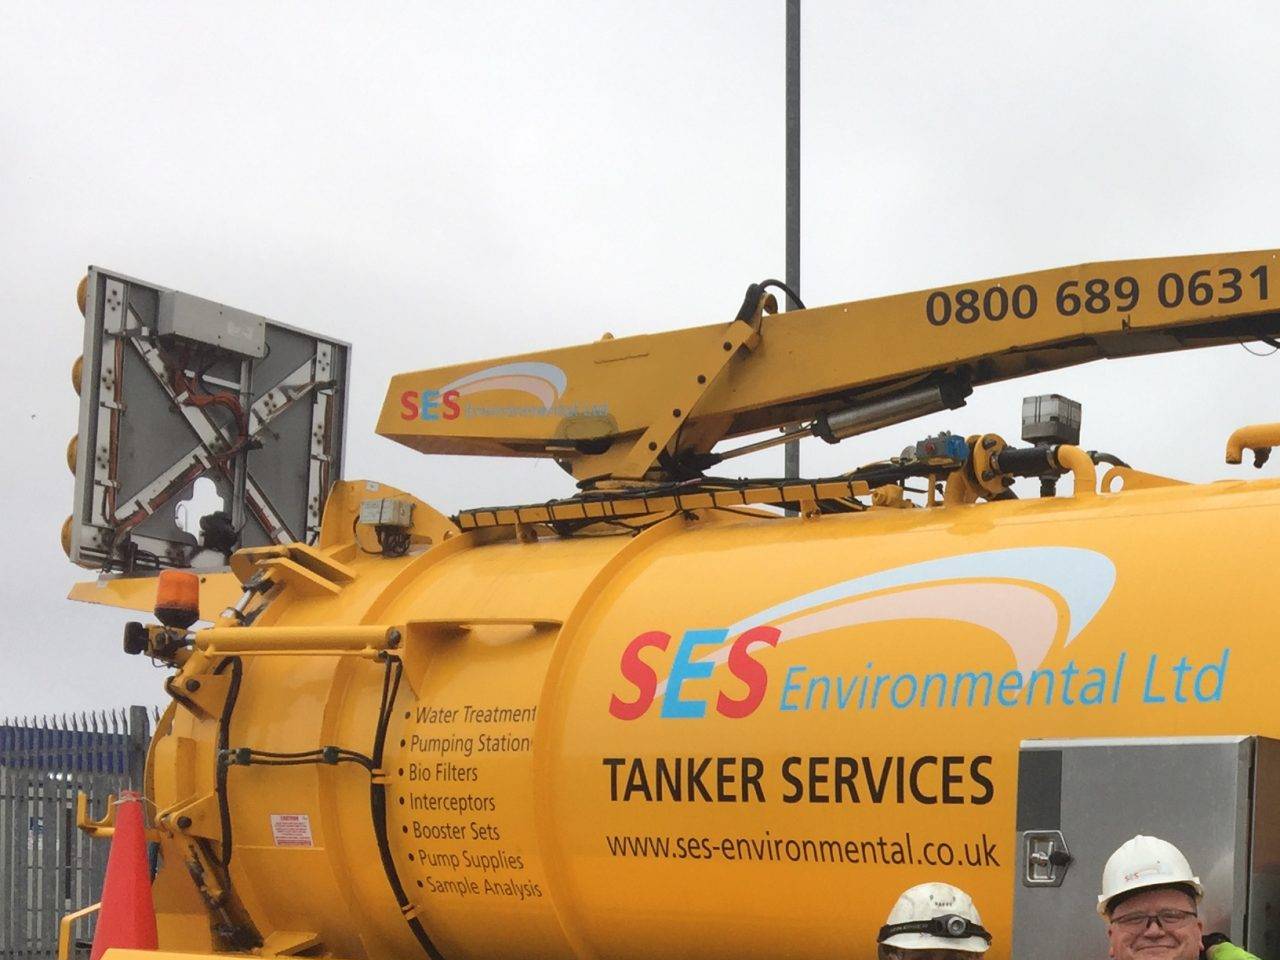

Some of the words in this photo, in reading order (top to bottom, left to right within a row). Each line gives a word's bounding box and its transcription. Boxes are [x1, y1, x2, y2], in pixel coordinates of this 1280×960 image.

[926, 284, 1038, 326] 0800
[1056, 276, 1140, 316] 689
[1157, 265, 1269, 309] 0631
[400, 388, 461, 421] SES
[609, 625, 782, 721] SES
[779, 651, 1128, 712] Environmental
[1141, 647, 1231, 704] Ltd
[416, 706, 459, 724] Water
[410, 734, 474, 758] Pumping
[478, 733, 532, 752] Station
[409, 763, 431, 781] Bio
[435, 762, 478, 782] Filters
[603, 756, 766, 803] TANKER
[781, 755, 995, 805] SERVICES
[410, 793, 496, 815] Interceptors
[413, 821, 466, 840] Booster
[470, 821, 500, 840] Sets
[418, 849, 460, 871] Pump
[462, 848, 524, 873] Supplies
[606, 831, 1001, 867] www.ses-environmental.co.uk
[426, 876, 480, 897] Sample
[484, 879, 543, 900] Analysis
